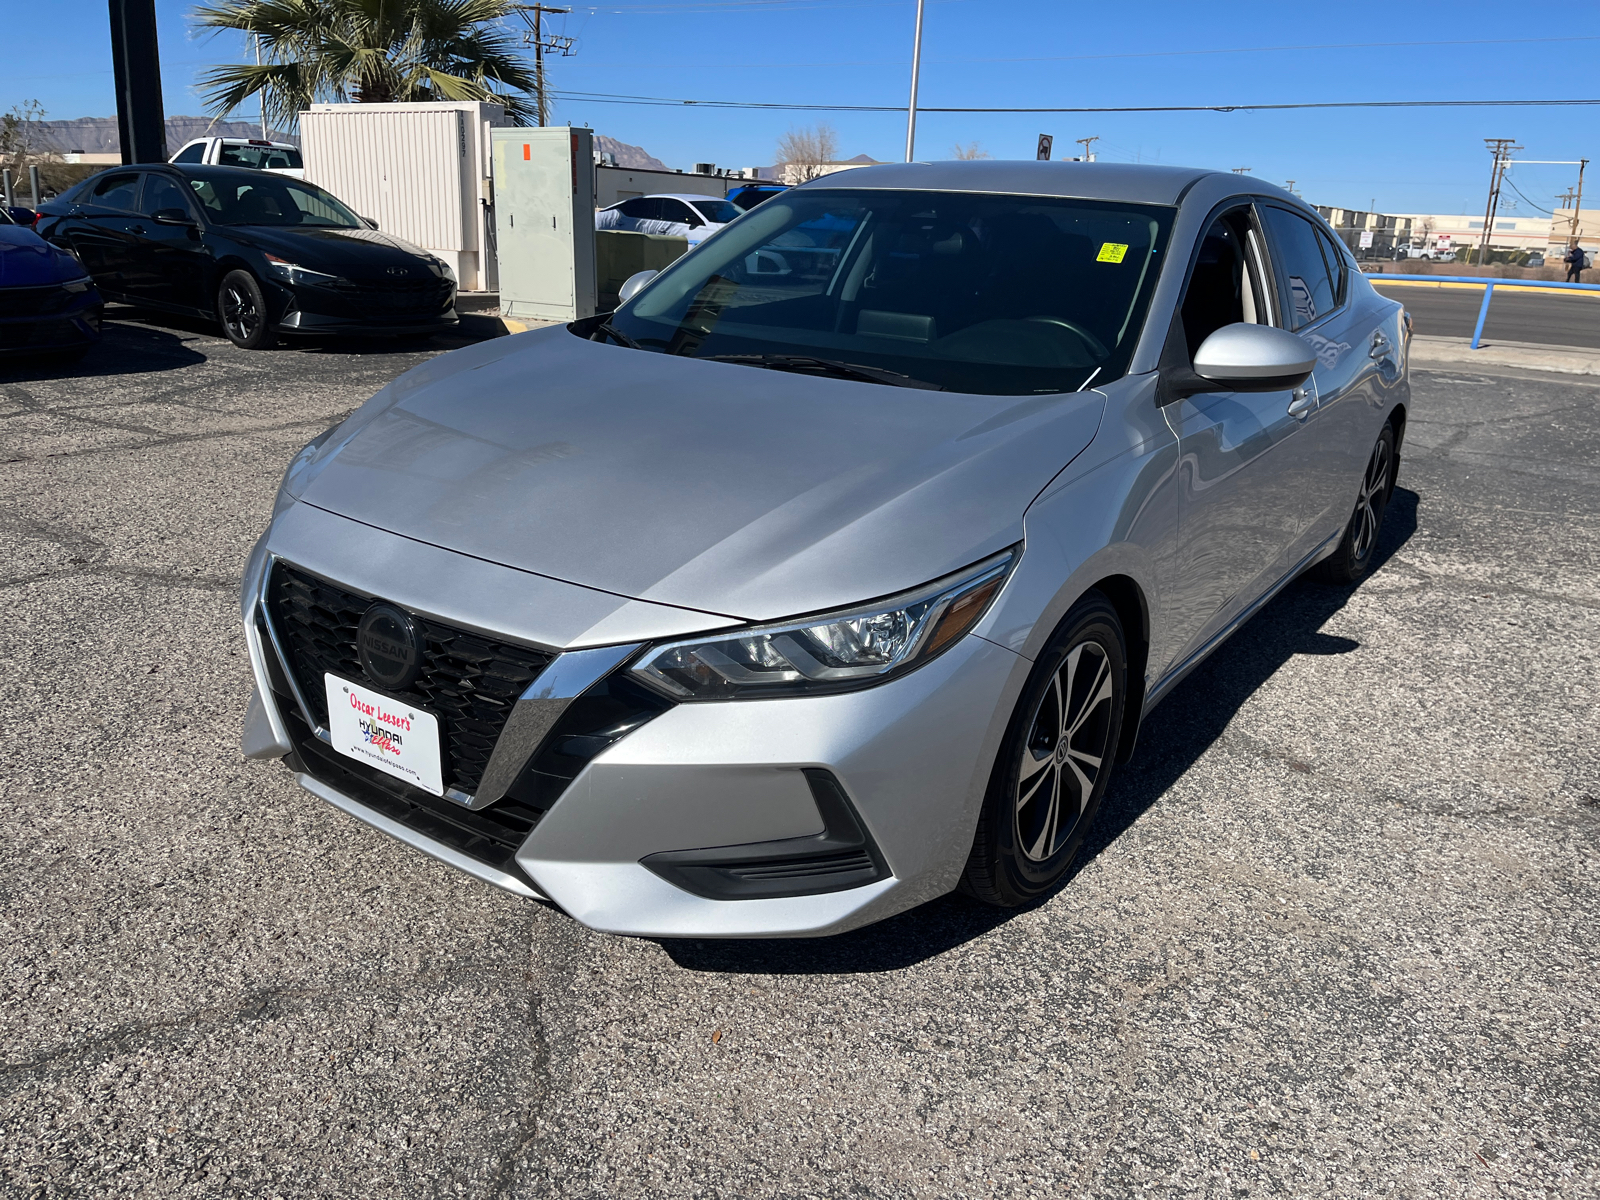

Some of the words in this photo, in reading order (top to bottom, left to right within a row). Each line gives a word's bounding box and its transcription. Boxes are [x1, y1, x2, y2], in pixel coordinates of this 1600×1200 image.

[363, 634, 408, 661] NISSAN
[350, 693, 375, 717] Oscar
[377, 706, 411, 731] Leeser's
[358, 718, 403, 745] HYUNDAI
